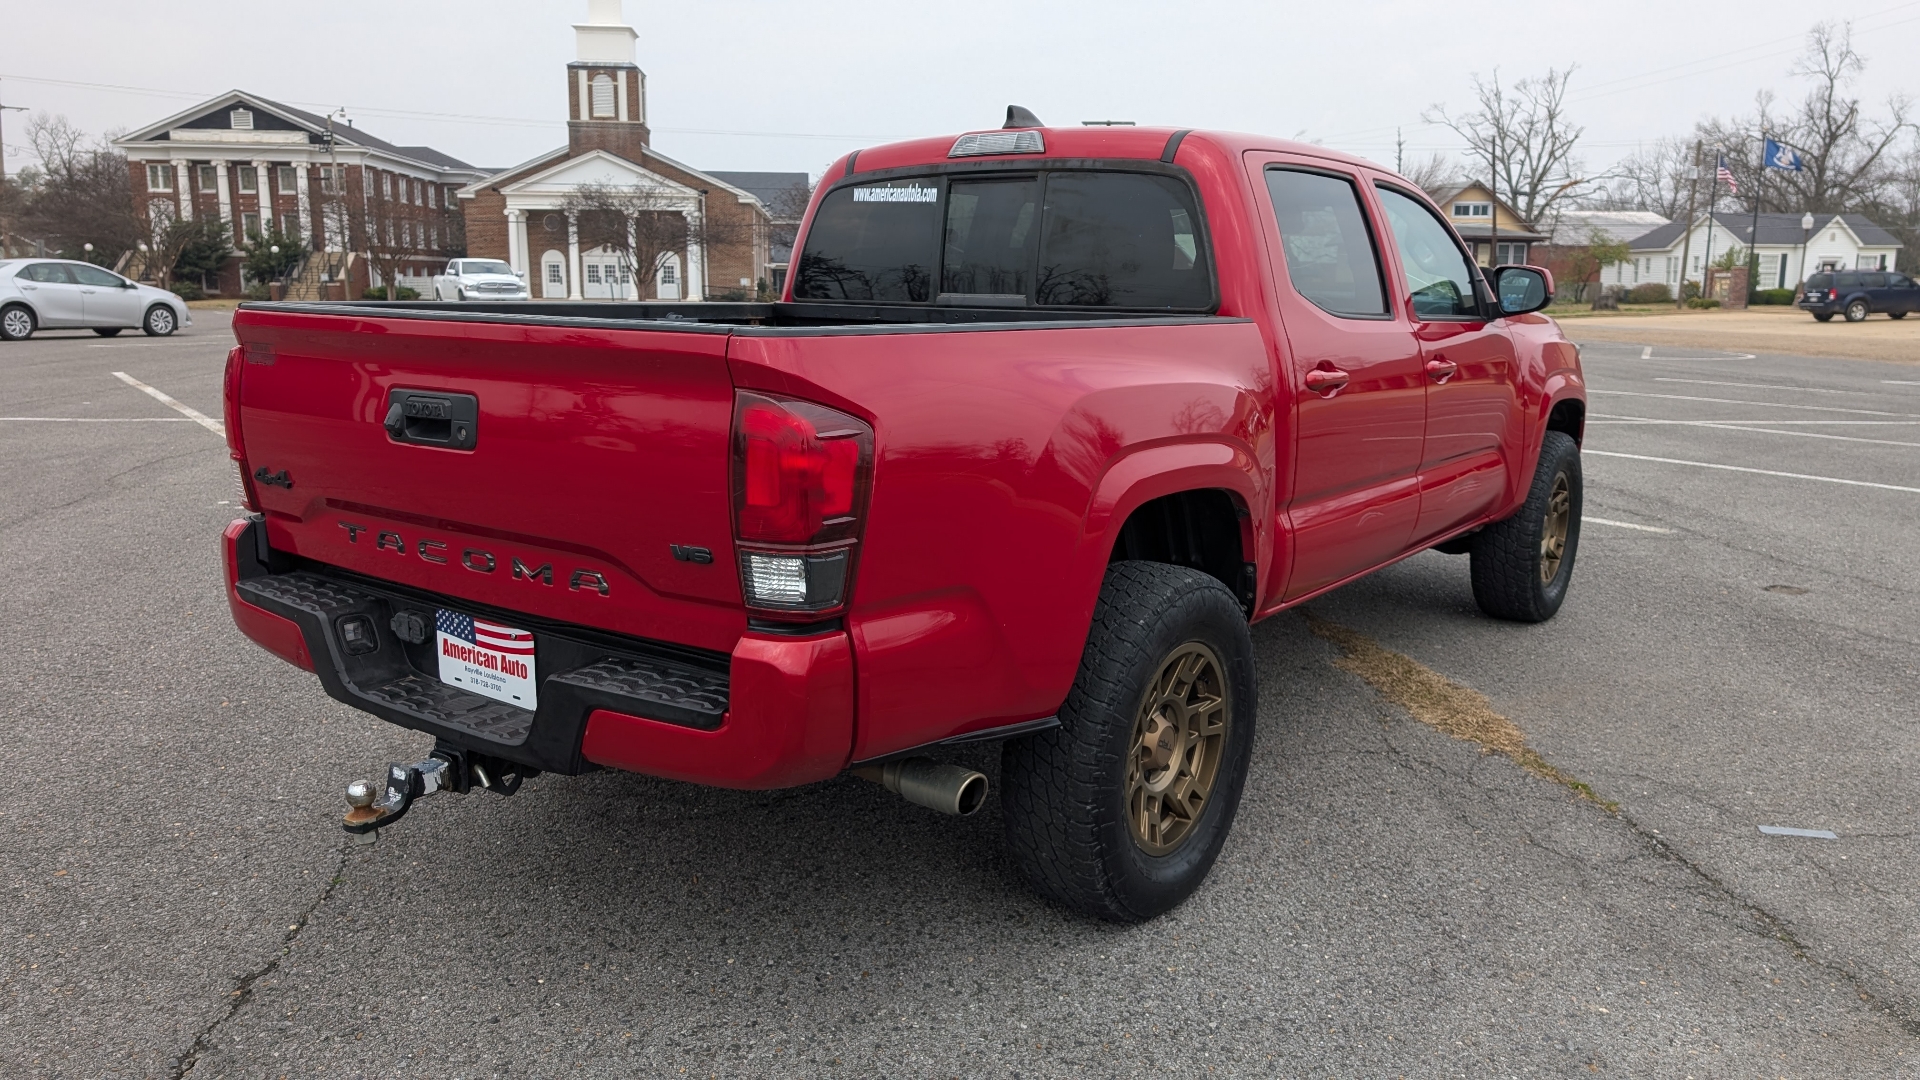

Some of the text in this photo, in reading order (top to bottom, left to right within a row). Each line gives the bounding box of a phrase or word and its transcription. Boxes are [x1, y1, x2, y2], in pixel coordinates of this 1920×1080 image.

[853, 183, 937, 202] www.americanautola.com
[406, 401, 445, 418] TOYOTA
[338, 521, 610, 598] TACOMA
[669, 544, 714, 565] V6
[443, 638, 527, 679] American Auto
